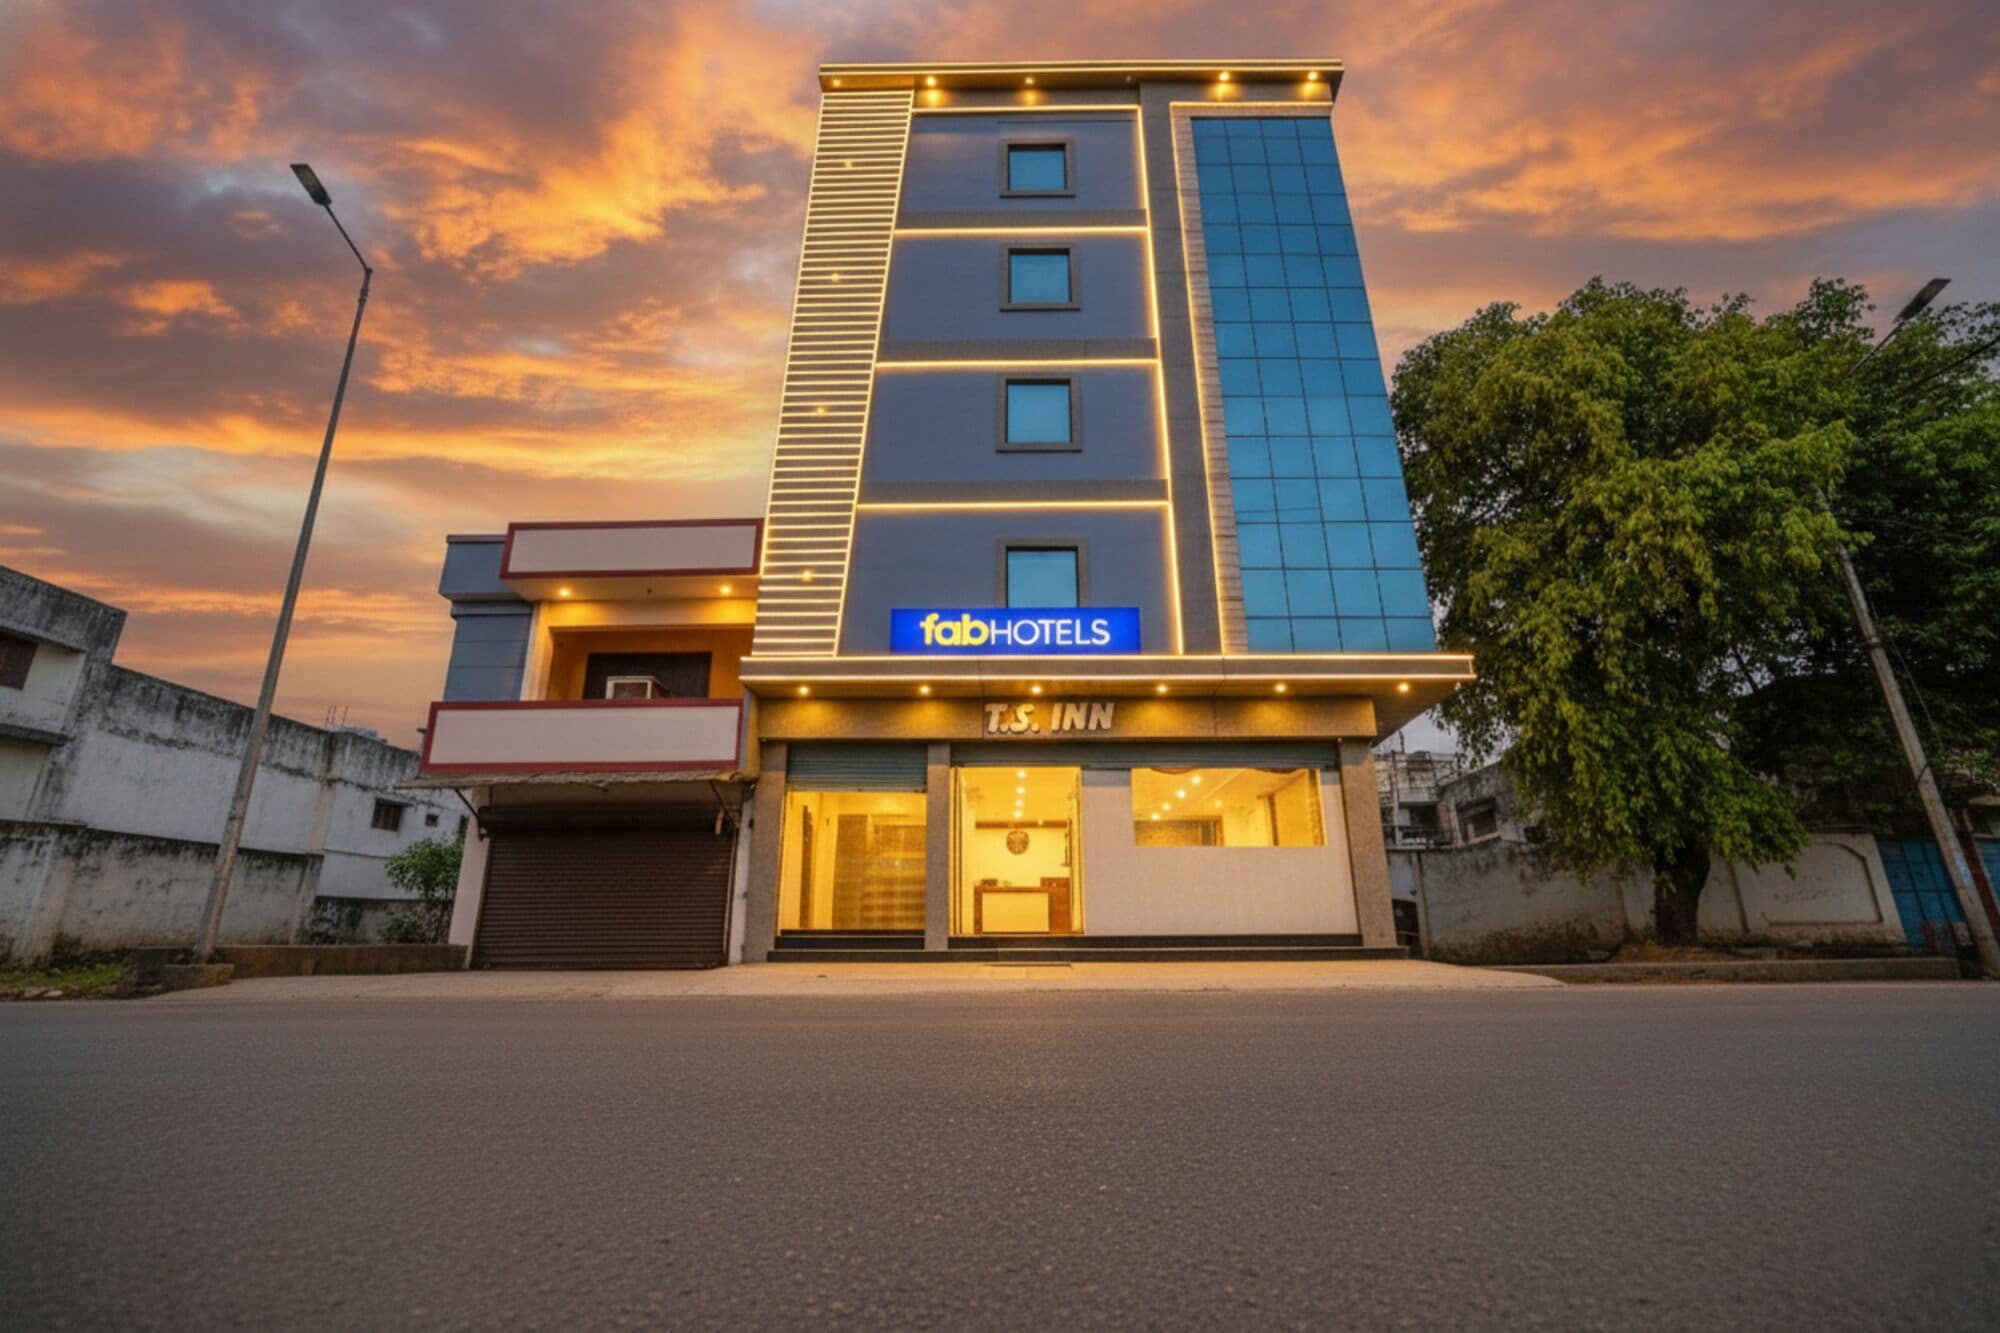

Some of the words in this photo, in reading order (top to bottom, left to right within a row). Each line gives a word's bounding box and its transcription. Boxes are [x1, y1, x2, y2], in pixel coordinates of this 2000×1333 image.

[919, 613, 1111, 646] fabHOTELS
[984, 703, 1040, 733] T.S.
[1051, 702, 1115, 732] INN
